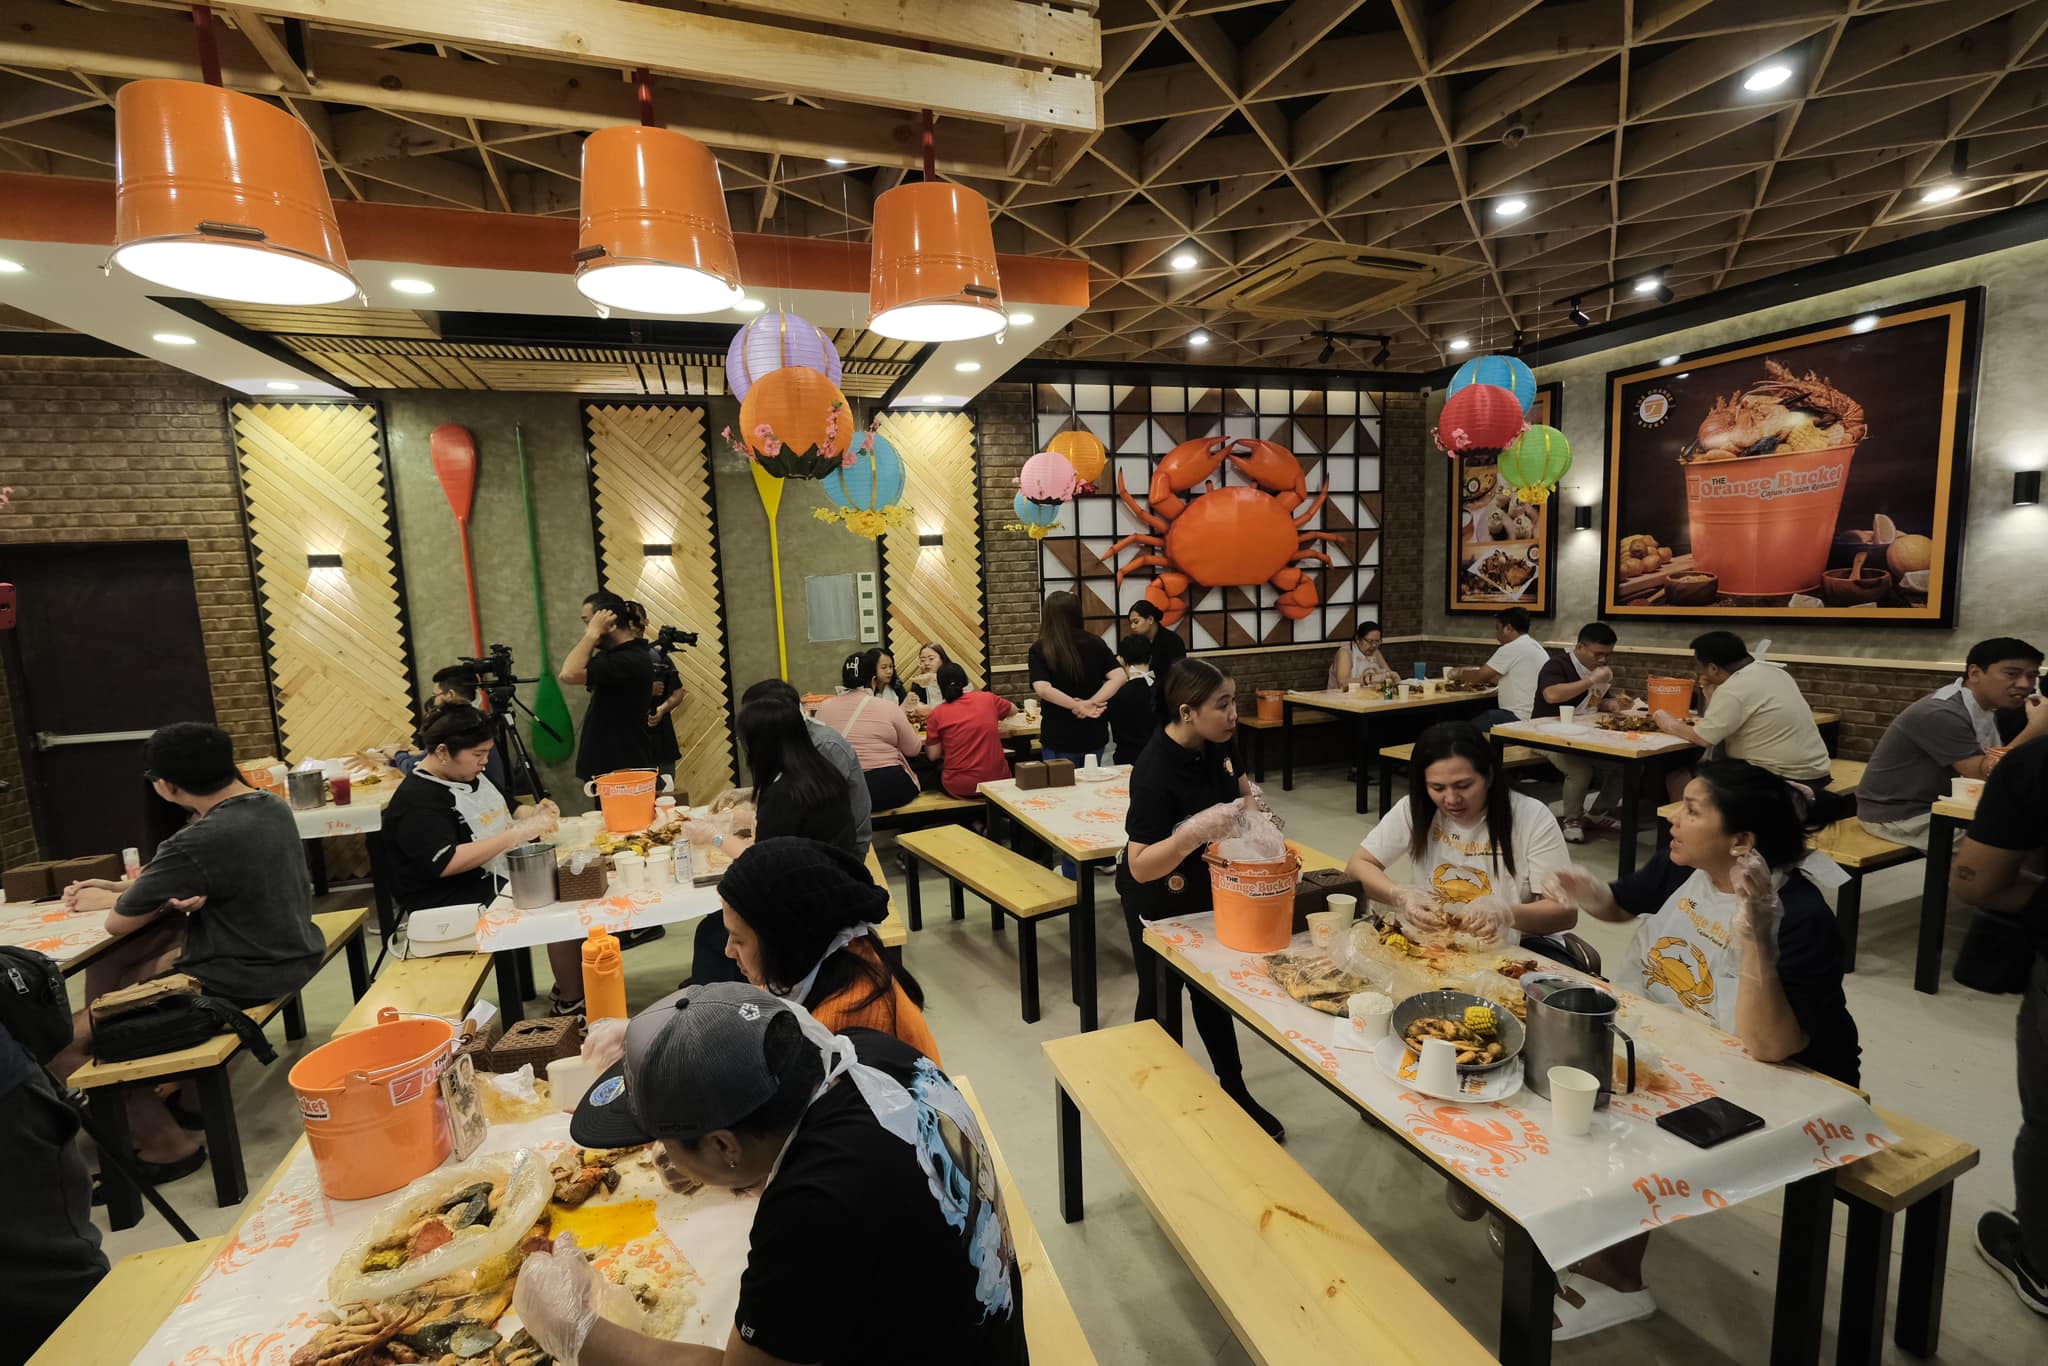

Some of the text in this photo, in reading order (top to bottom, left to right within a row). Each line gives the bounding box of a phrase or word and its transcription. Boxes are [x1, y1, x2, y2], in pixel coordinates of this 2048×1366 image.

[1700, 464, 1844, 498] Orange Bucket
[1711, 477, 1727, 486] THE
[1226, 875, 1239, 883] THE
[1229, 968, 1287, 999] Bucke
[1489, 1101, 1551, 1156] range
[1802, 1117, 1856, 1147] The
[1632, 1172, 1691, 1205] The
